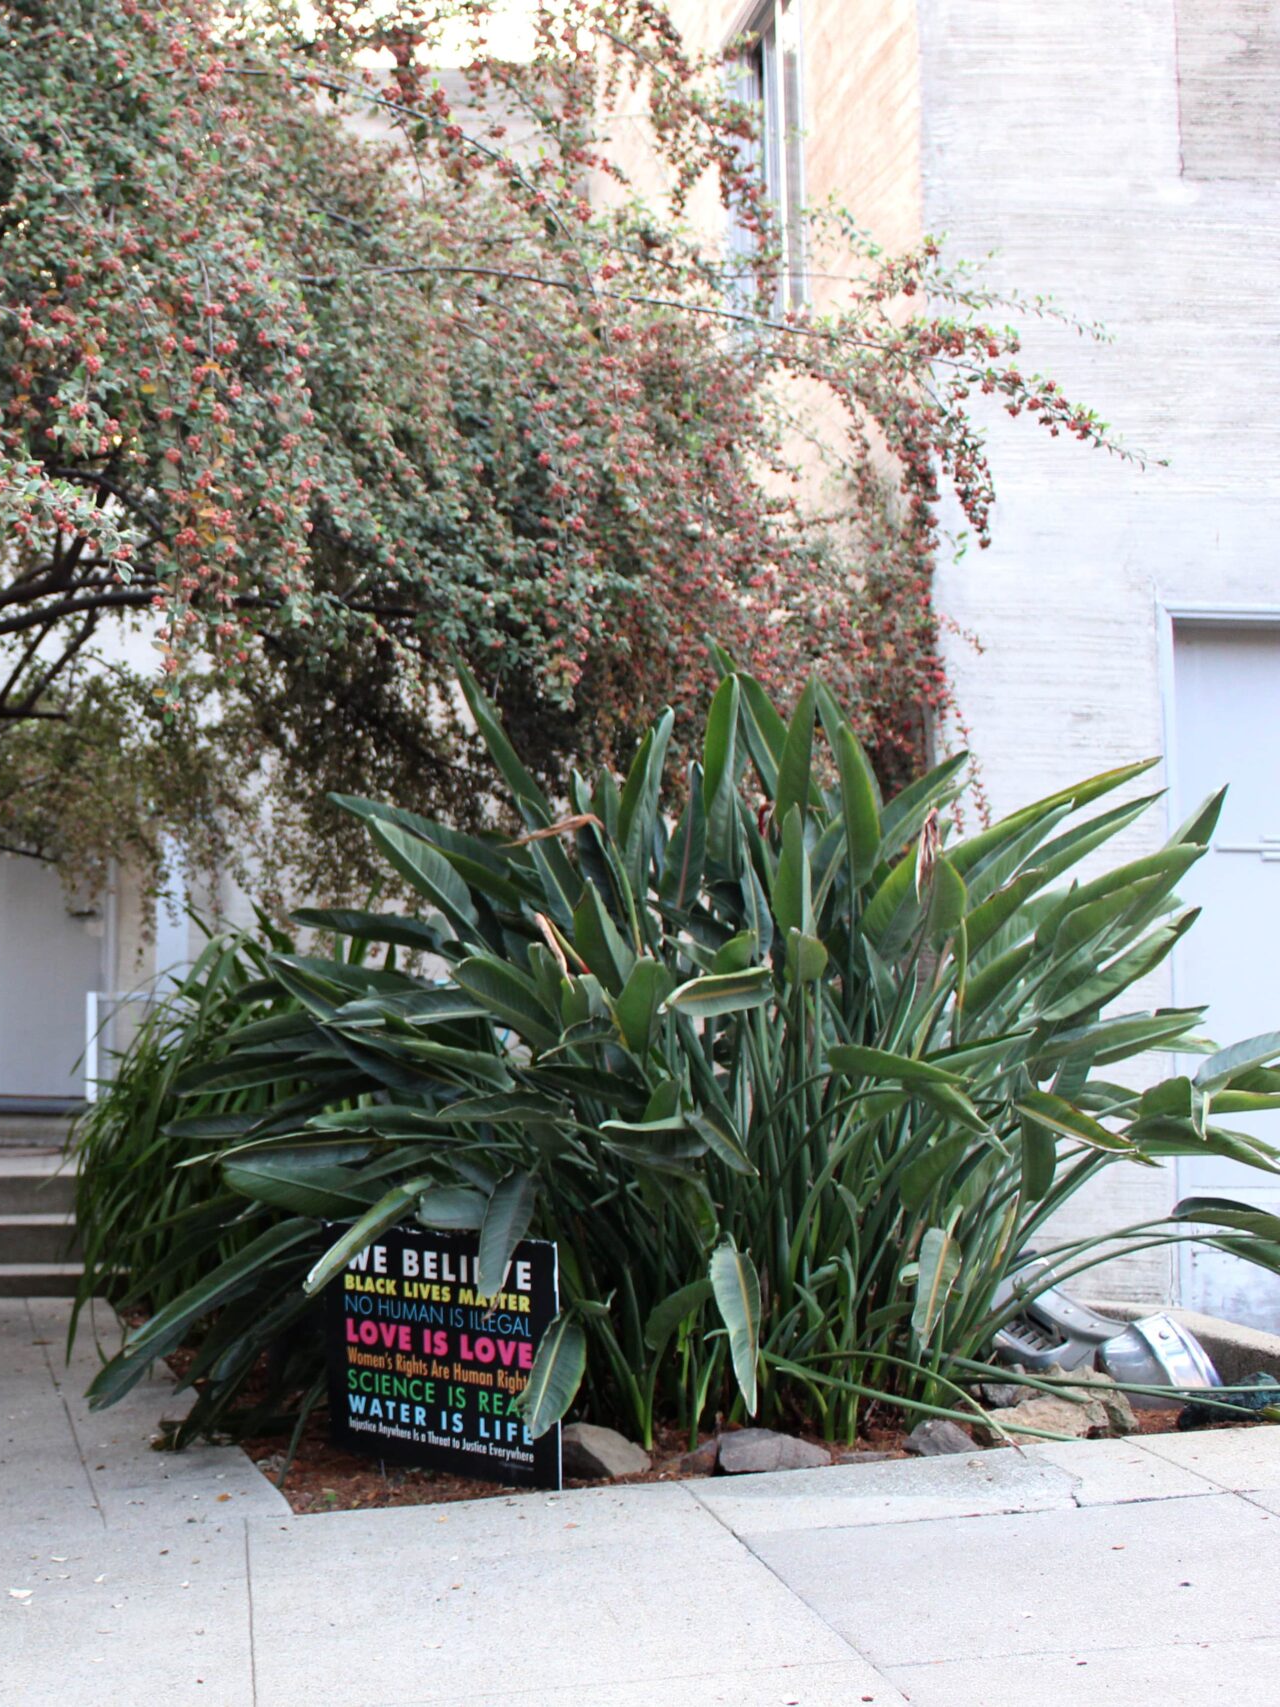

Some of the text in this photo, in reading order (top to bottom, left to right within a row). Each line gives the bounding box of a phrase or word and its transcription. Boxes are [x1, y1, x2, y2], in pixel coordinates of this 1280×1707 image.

[348, 1244, 387, 1274] WE
[344, 1274, 397, 1296] BLACK
[403, 1281, 451, 1303] LIVES
[345, 1294, 532, 1337] NO HUMAN IS ILLEGAL
[345, 1318, 532, 1369] LOVE IS LOVE
[347, 1348, 528, 1395] Women's Rights Are Human Right
[348, 1369, 524, 1417] SCIENCE IS REA
[348, 1394, 534, 1446] WATER IS LIFE
[349, 1416, 376, 1433] Injustice
[379, 1421, 412, 1440] Anywhere
[428, 1431, 450, 1447] Threat
[452, 1437, 460, 1449] to
[462, 1438, 487, 1454] Justice
[489, 1443, 534, 1463] Everywhere
